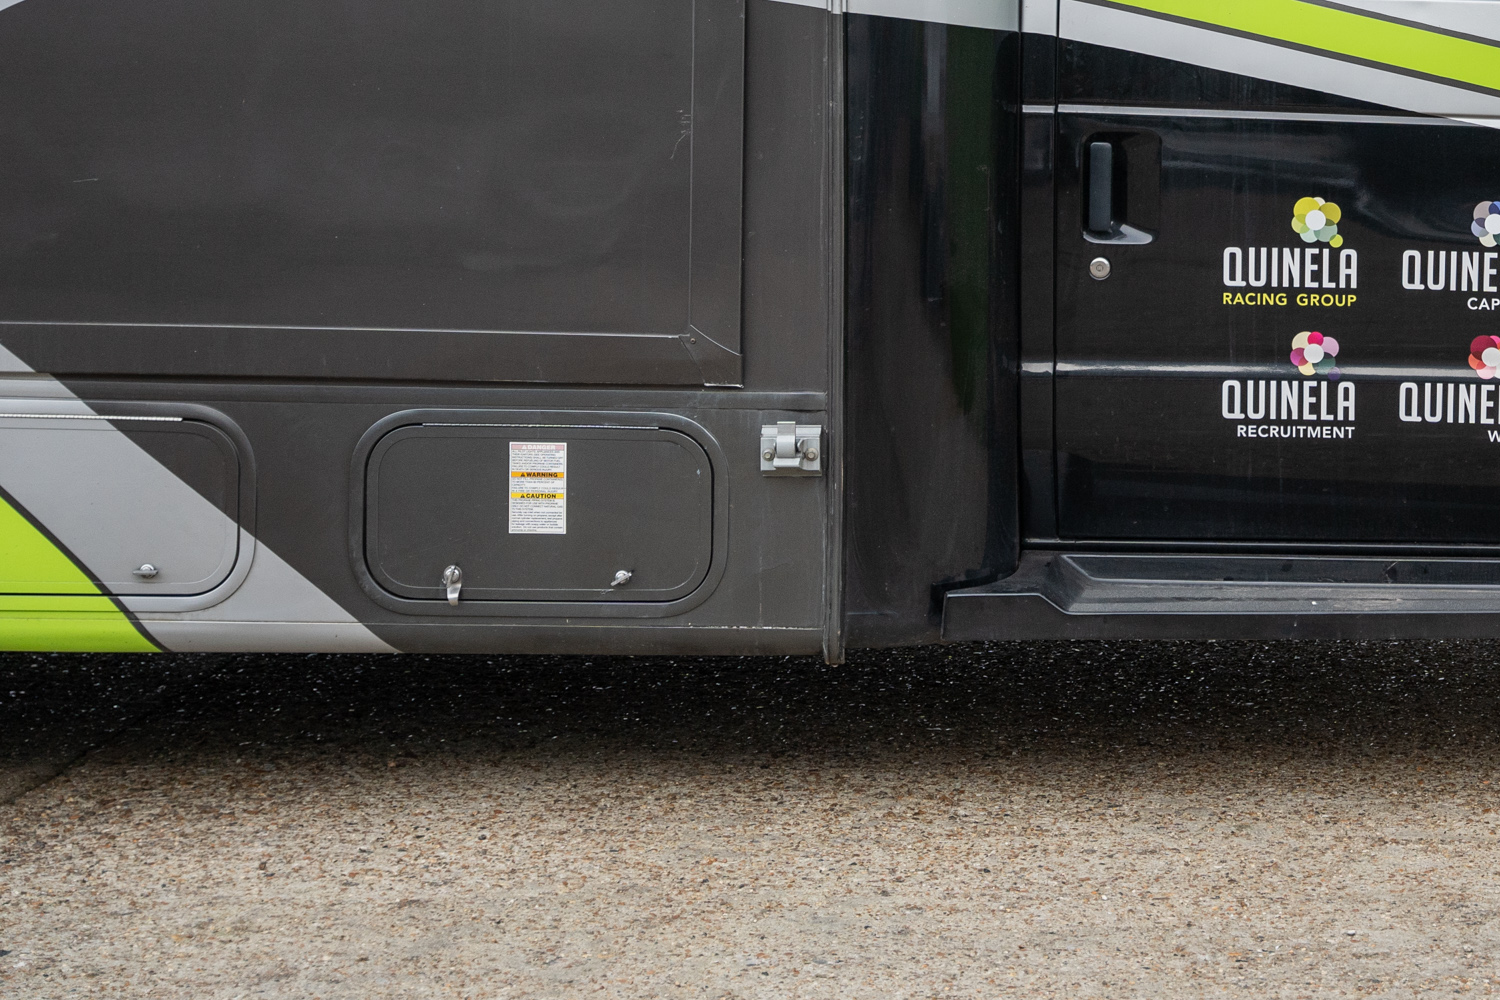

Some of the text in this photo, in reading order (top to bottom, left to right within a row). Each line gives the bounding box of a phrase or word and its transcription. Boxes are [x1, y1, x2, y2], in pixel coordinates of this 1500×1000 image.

[1222, 246, 1358, 289] QUINELA
[1222, 292, 1357, 307] RACING GROUP
[1221, 379, 1356, 422] QUINELA
[1237, 425, 1356, 439] RECRUITMENT
